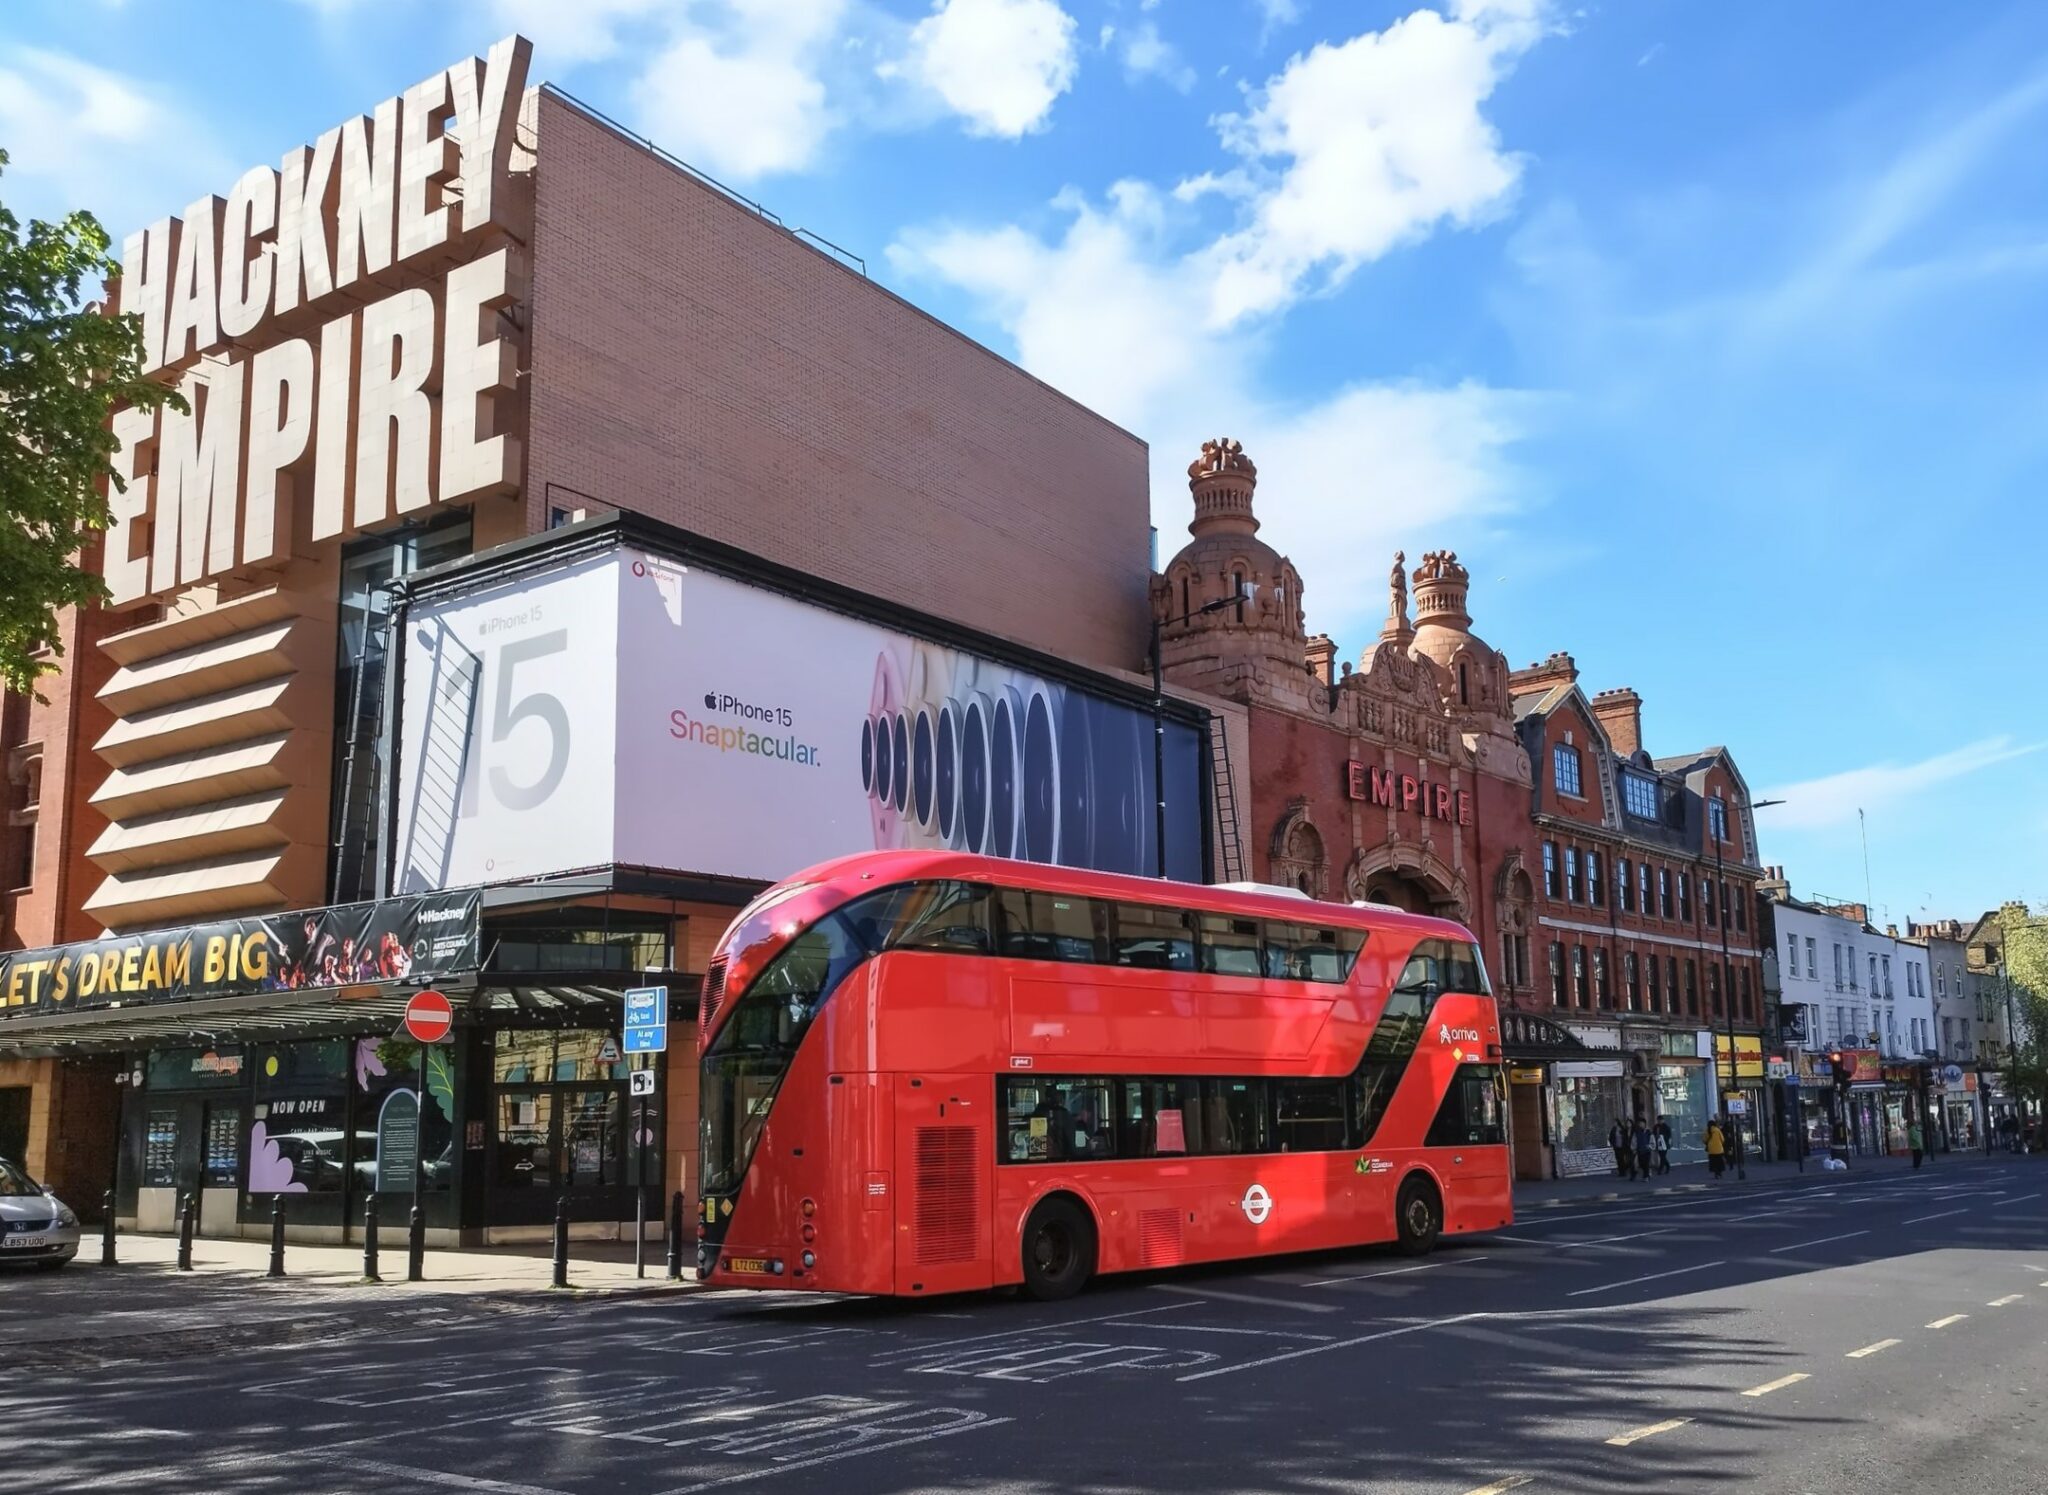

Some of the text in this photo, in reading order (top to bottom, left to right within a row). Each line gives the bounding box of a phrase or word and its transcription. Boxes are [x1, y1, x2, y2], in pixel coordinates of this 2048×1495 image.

[122, 33, 533, 378] HACKNEY
[103, 246, 523, 610] EMPIRE
[486, 605, 543, 635] iPhone 15
[444, 628, 571, 820] 15
[669, 708, 822, 769] Snaptacular.
[718, 692, 793, 728] iPhone 15
[1347, 759, 1473, 828] EMPIRE
[427, 907, 467, 924] Hackney
[78, 940, 194, 998] DREAM
[203, 930, 269, 984] BIG
[1451, 1026, 1478, 1041] arriva
[271, 1099, 325, 1114] NOW OPEN
[509, 1386, 988, 1462] CLEAR
